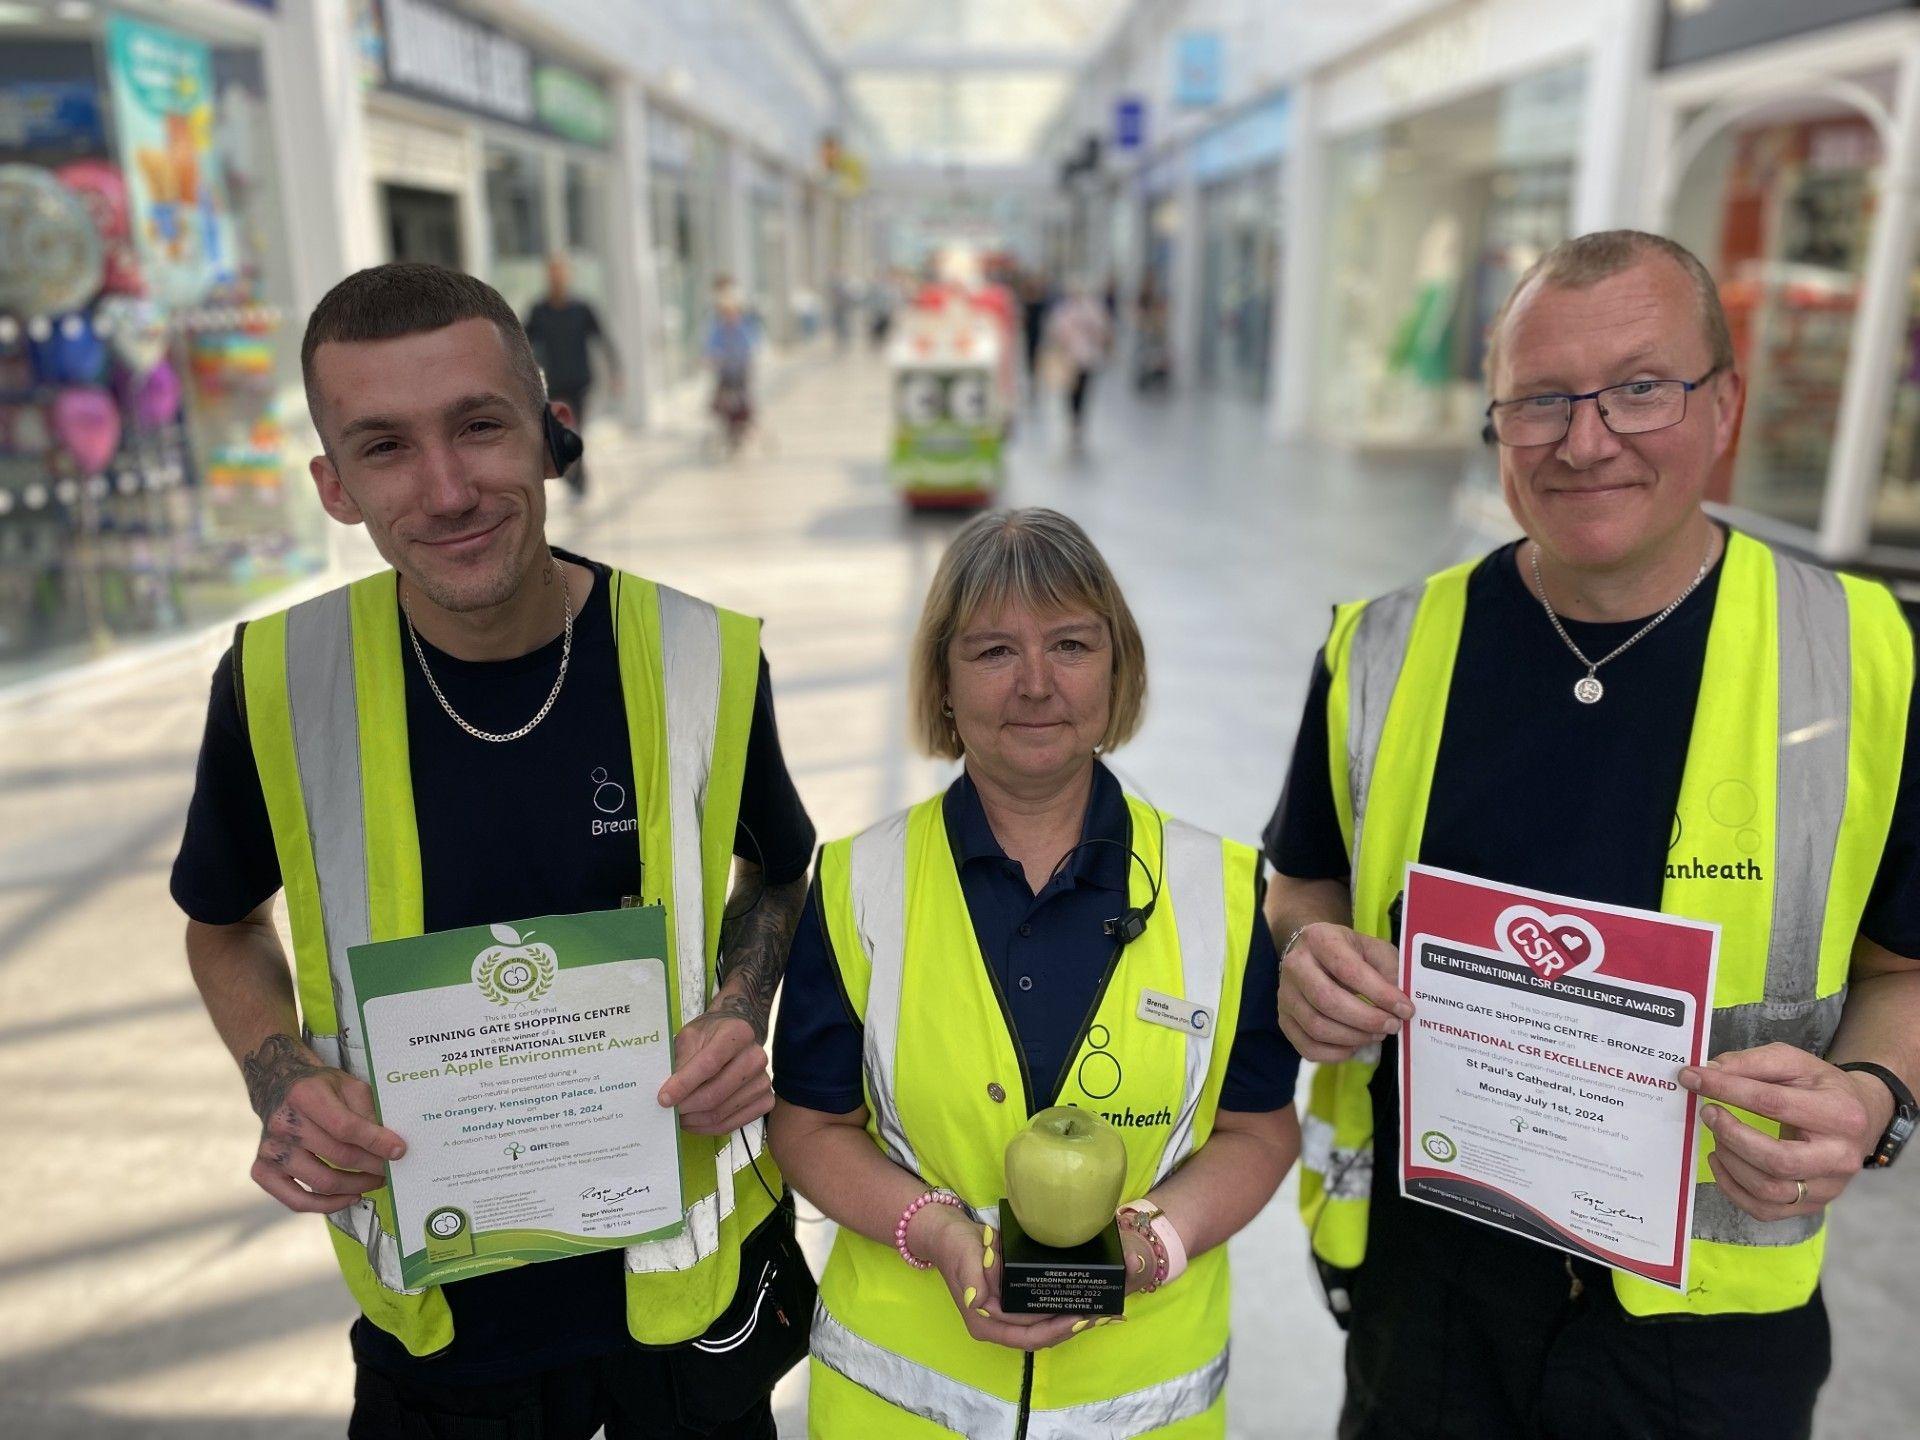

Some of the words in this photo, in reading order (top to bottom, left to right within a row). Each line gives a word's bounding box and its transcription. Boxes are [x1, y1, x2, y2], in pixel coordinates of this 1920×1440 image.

[592, 819, 637, 835] Brean
[1665, 857, 1763, 880] anheath
[1512, 923, 1565, 977] CSR
[1427, 952, 1447, 965] THE
[1449, 957, 1529, 985] INTERNATIONAL
[1530, 977, 1552, 989] CSR
[1554, 982, 1624, 1006] EXCELLENCE
[1625, 999, 1676, 1018] AWARDS
[518, 1007, 542, 1018] certify
[1147, 998, 1169, 1010] Brenda
[1511, 1002, 1523, 1010] This
[1540, 1009, 1563, 1022] certify
[1564, 1014, 1578, 1023] that
[409, 1028, 476, 1046] SPINNING
[480, 1022, 511, 1035] GATE
[514, 1013, 580, 1030] SHOPPING
[584, 1005, 630, 1020] CENTRE
[512, 1032, 540, 1041] winner
[1415, 991, 1464, 1010] SPINNING
[1466, 1004, 1493, 1017] GATE
[1495, 1010, 1551, 1030] SHOPPING
[1554, 1025, 1599, 1042] CENTRE
[1607, 1038, 1655, 1056] BRONZE
[1658, 1050, 1686, 1064] 2024
[1530, 1033, 1557, 1044] winner
[387, 1068, 440, 1084] Green
[444, 1059, 493, 1076] Apple
[499, 1043, 604, 1067] Environment
[607, 1030, 660, 1050] Award
[441, 1051, 468, 1062] 2024
[471, 1037, 565, 1058] INTERNATIONAL
[568, 1030, 606, 1043] SILVER
[1420, 1018, 1514, 1051] INTERNATIONAL
[1517, 1044, 1540, 1058] CSR
[1544, 1050, 1624, 1079] EXCELLENCE
[1626, 1072, 1677, 1092] AWARD
[458, 1088, 509, 1102] carbon-neutral
[511, 1082, 554, 1094] presentation
[557, 1076, 591, 1086] ceremony
[512, 1072, 547, 1084] presented
[548, 1069, 571, 1078] during
[1466, 1059, 1478, 1069] St
[1481, 1062, 1513, 1078] Paul's
[1516, 1072, 1576, 1096] Cathedral,
[1579, 1089, 1624, 1107] London
[422, 1113, 442, 1122] The
[444, 1104, 497, 1118] Orangery,
[500, 1093, 558, 1108] Kensington
[561, 1088, 597, 1099] Palace,
[600, 1080, 637, 1092] London
[1479, 1082, 1522, 1102] Monday
[1525, 1095, 1548, 1108] July
[1552, 1102, 1571, 1115] 1st,
[1575, 1108, 1604, 1122] 2024
[451, 1136, 483, 1146] donation
[593, 1113, 614, 1122] behalf
[462, 1121, 504, 1133] Monday
[506, 1112, 560, 1126] November
[563, 1109, 577, 1117] 18,
[580, 1104, 603, 1114] 2024
